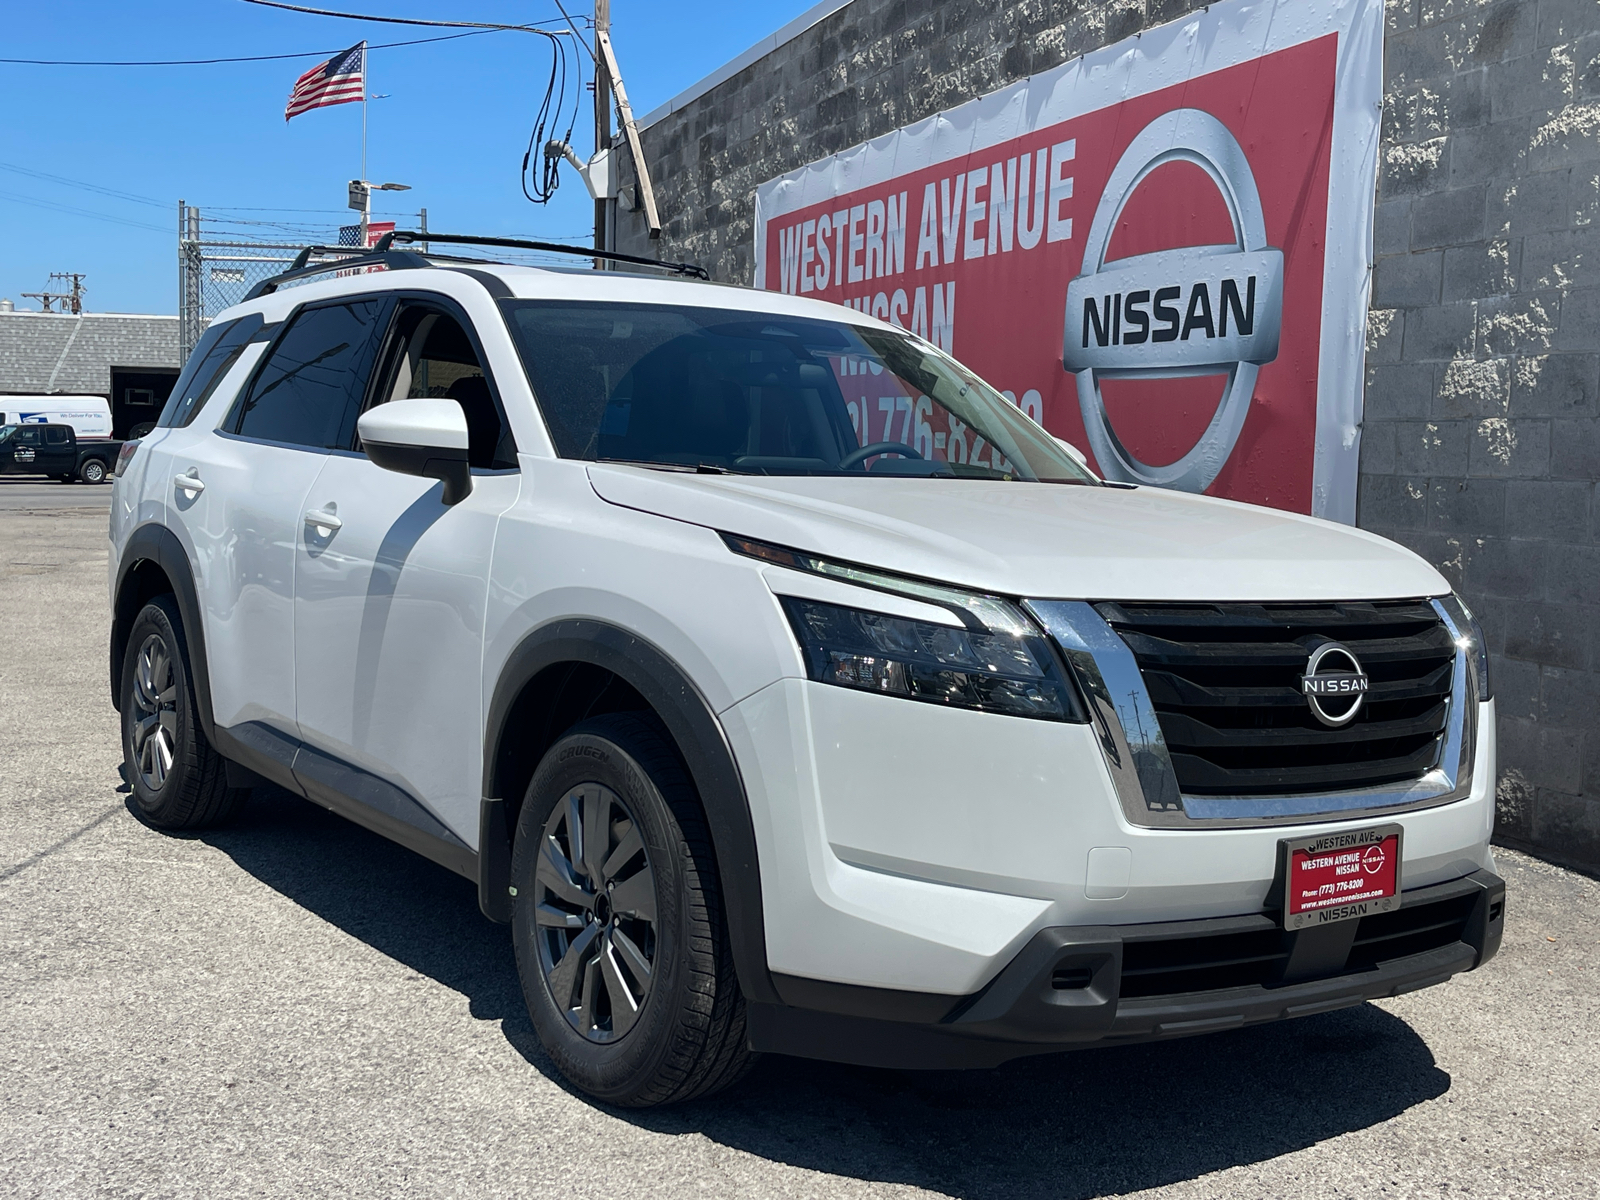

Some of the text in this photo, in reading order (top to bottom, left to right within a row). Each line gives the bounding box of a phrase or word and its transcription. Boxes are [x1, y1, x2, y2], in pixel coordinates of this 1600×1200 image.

[779, 138, 1077, 295] WESTERN AVENUE
[1082, 276, 1257, 349] NISSAN
[1304, 678, 1368, 692] NISSAN
[559, 745, 611, 764] CRUGEN
[1315, 831, 1376, 850] WESTERN AVE
[1301, 852, 1360, 870] WESTERN AVENUE
[1336, 863, 1360, 876] NISSAN
[1362, 856, 1385, 864] NISSAN
[1302, 878, 1364, 898] Phone: (773) 776-8200
[1301, 889, 1384, 910] www.westernavenissan.com
[1319, 903, 1368, 922] NISSAN
